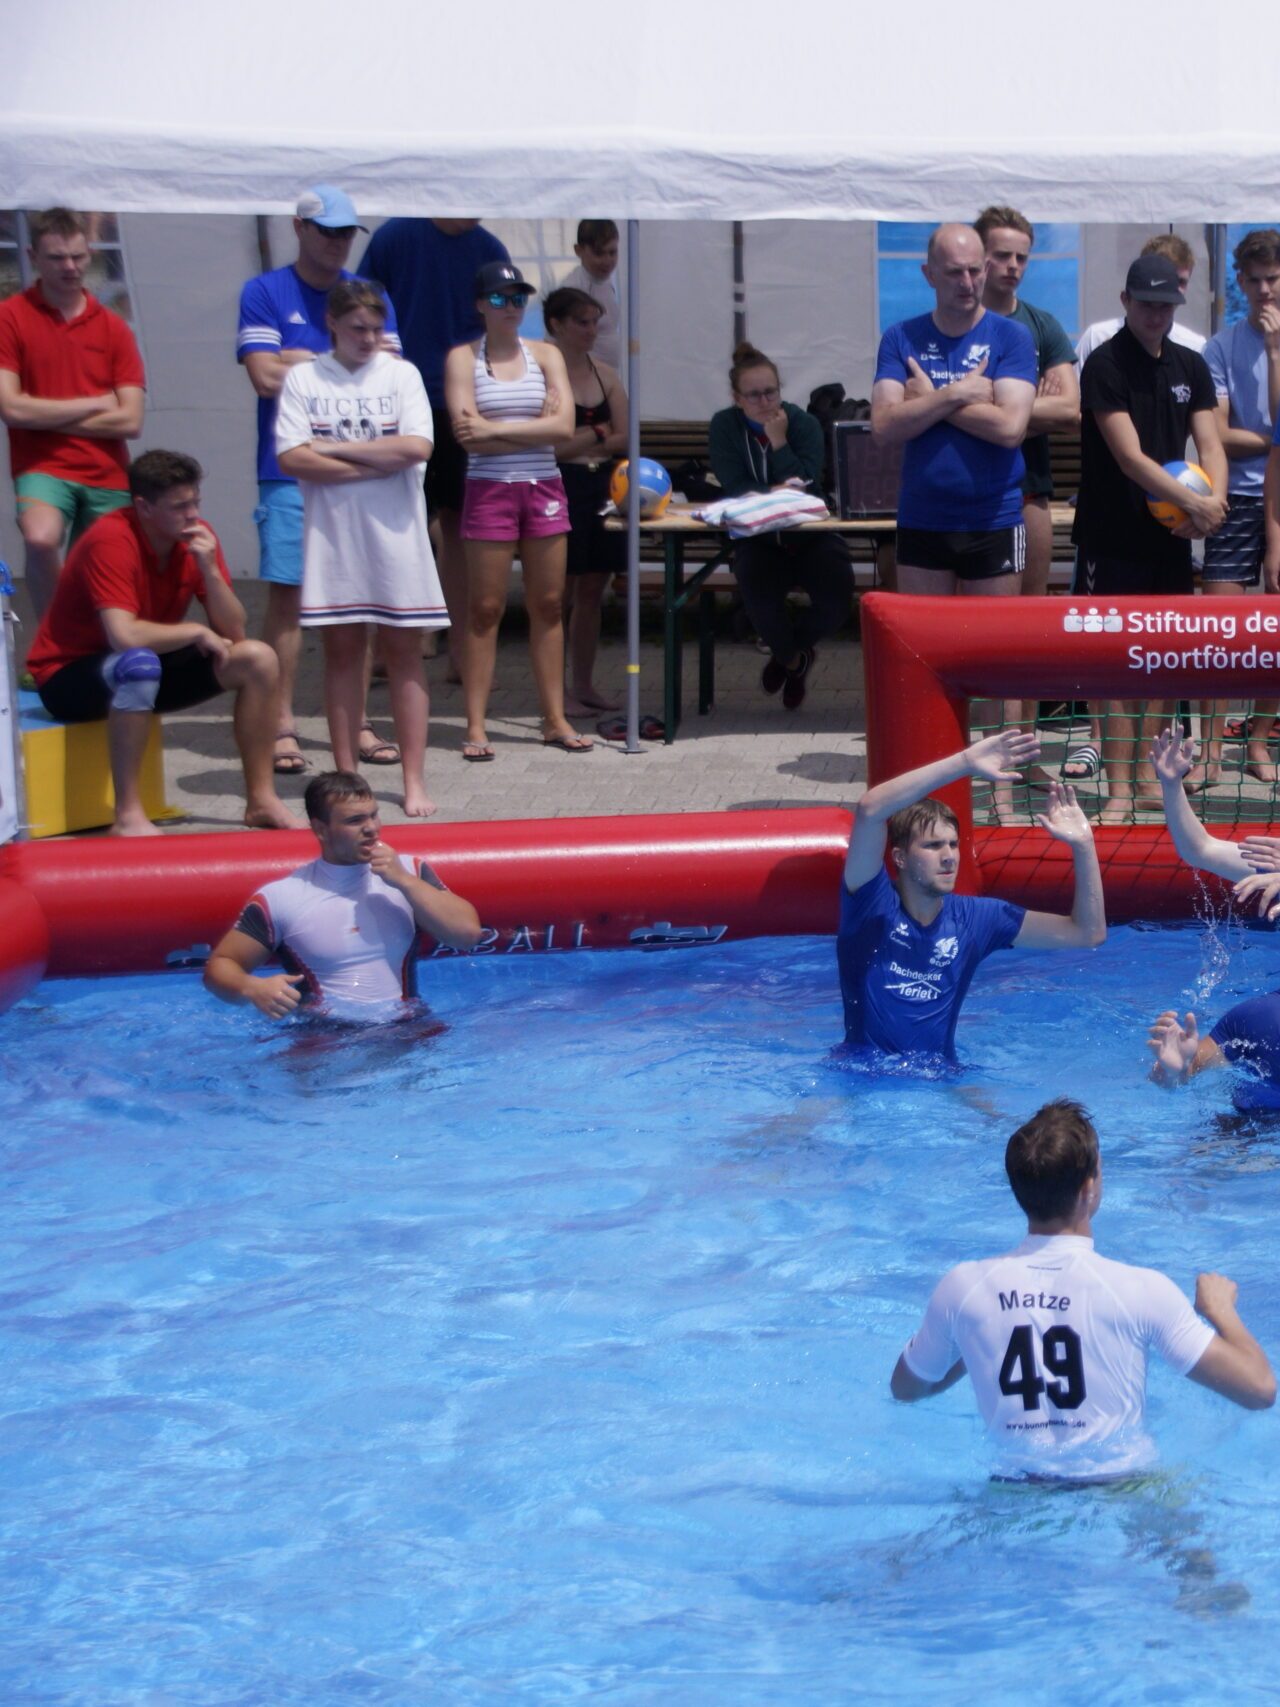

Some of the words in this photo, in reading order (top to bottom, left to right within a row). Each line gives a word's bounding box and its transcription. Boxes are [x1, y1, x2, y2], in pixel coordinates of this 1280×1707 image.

[304, 395, 398, 416] MICKE
[1127, 611, 1236, 639] Stiftung
[889, 961, 942, 981] Dachdecker
[998, 1289, 1072, 1312] Matze
[998, 1324, 1087, 1411] 49
